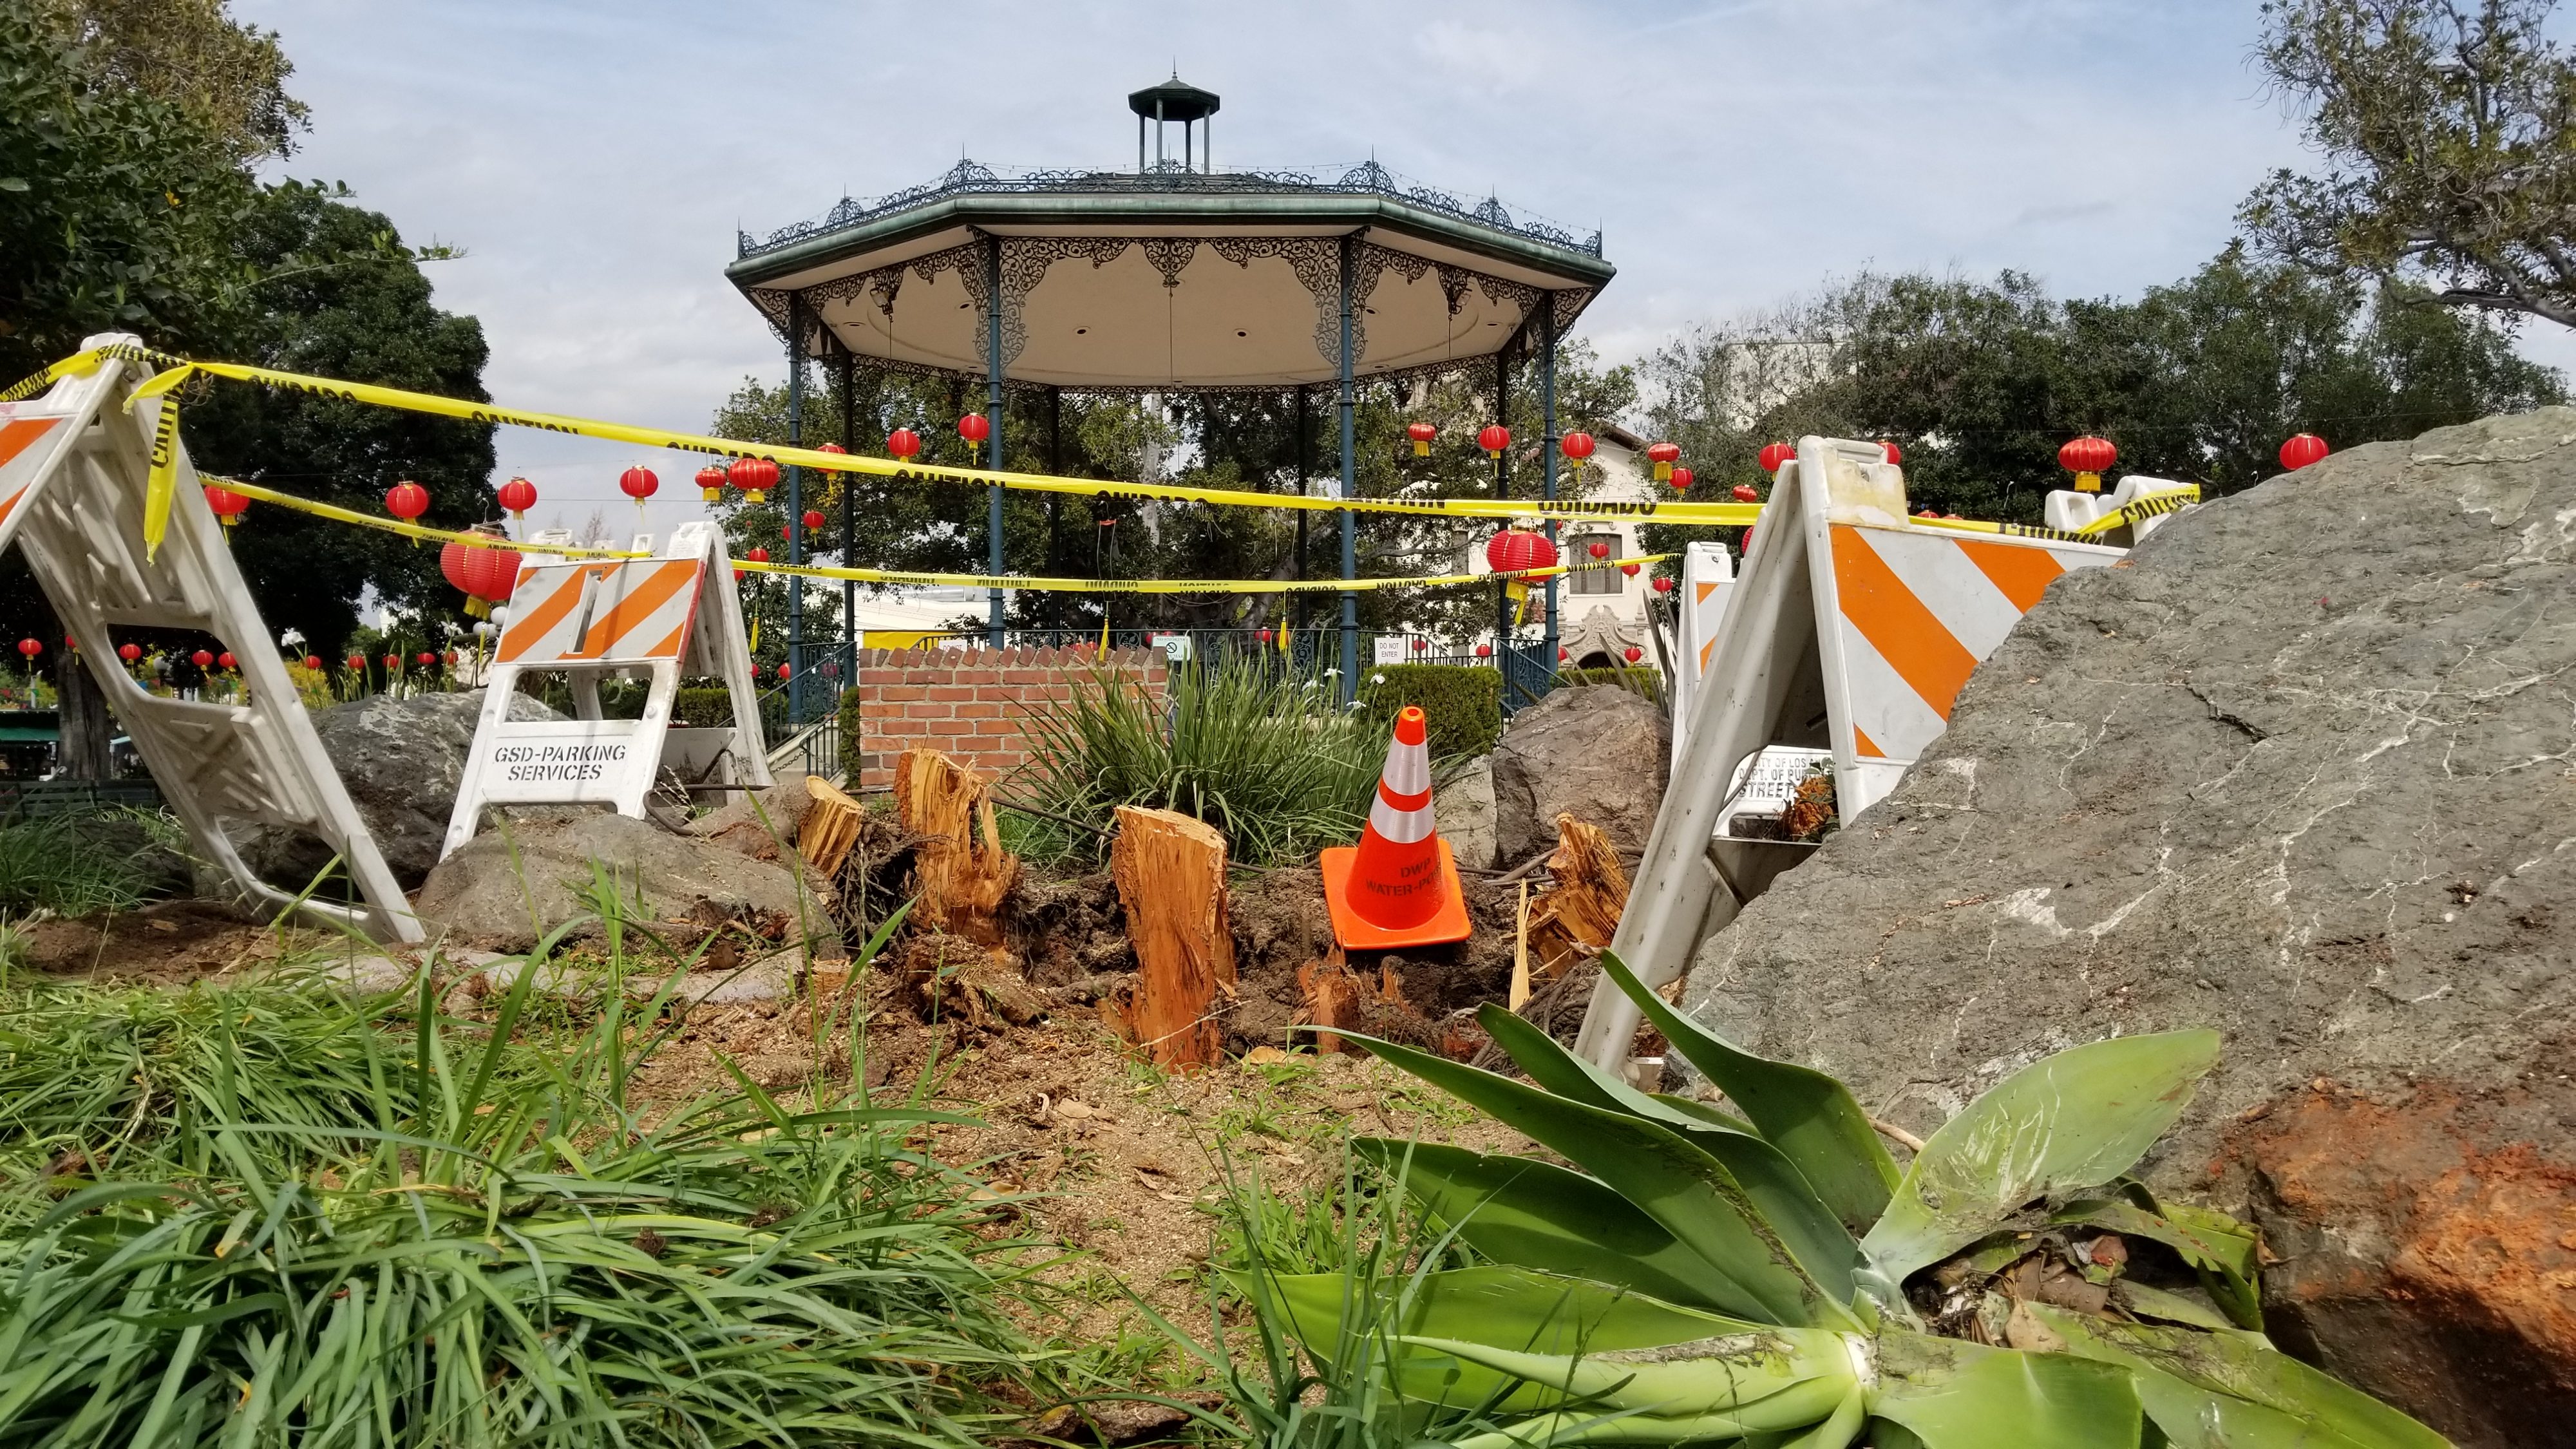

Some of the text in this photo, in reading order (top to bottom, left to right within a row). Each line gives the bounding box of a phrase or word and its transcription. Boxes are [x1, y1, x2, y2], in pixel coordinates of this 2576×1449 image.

[495, 745, 626, 762] GSD-PARKING
[1775, 757, 1786, 768] OF
[1789, 757, 1806, 768] LOS
[507, 764, 602, 781] SERVICES
[1771, 769, 1784, 781] OF
[1401, 857, 1430, 878] DWP
